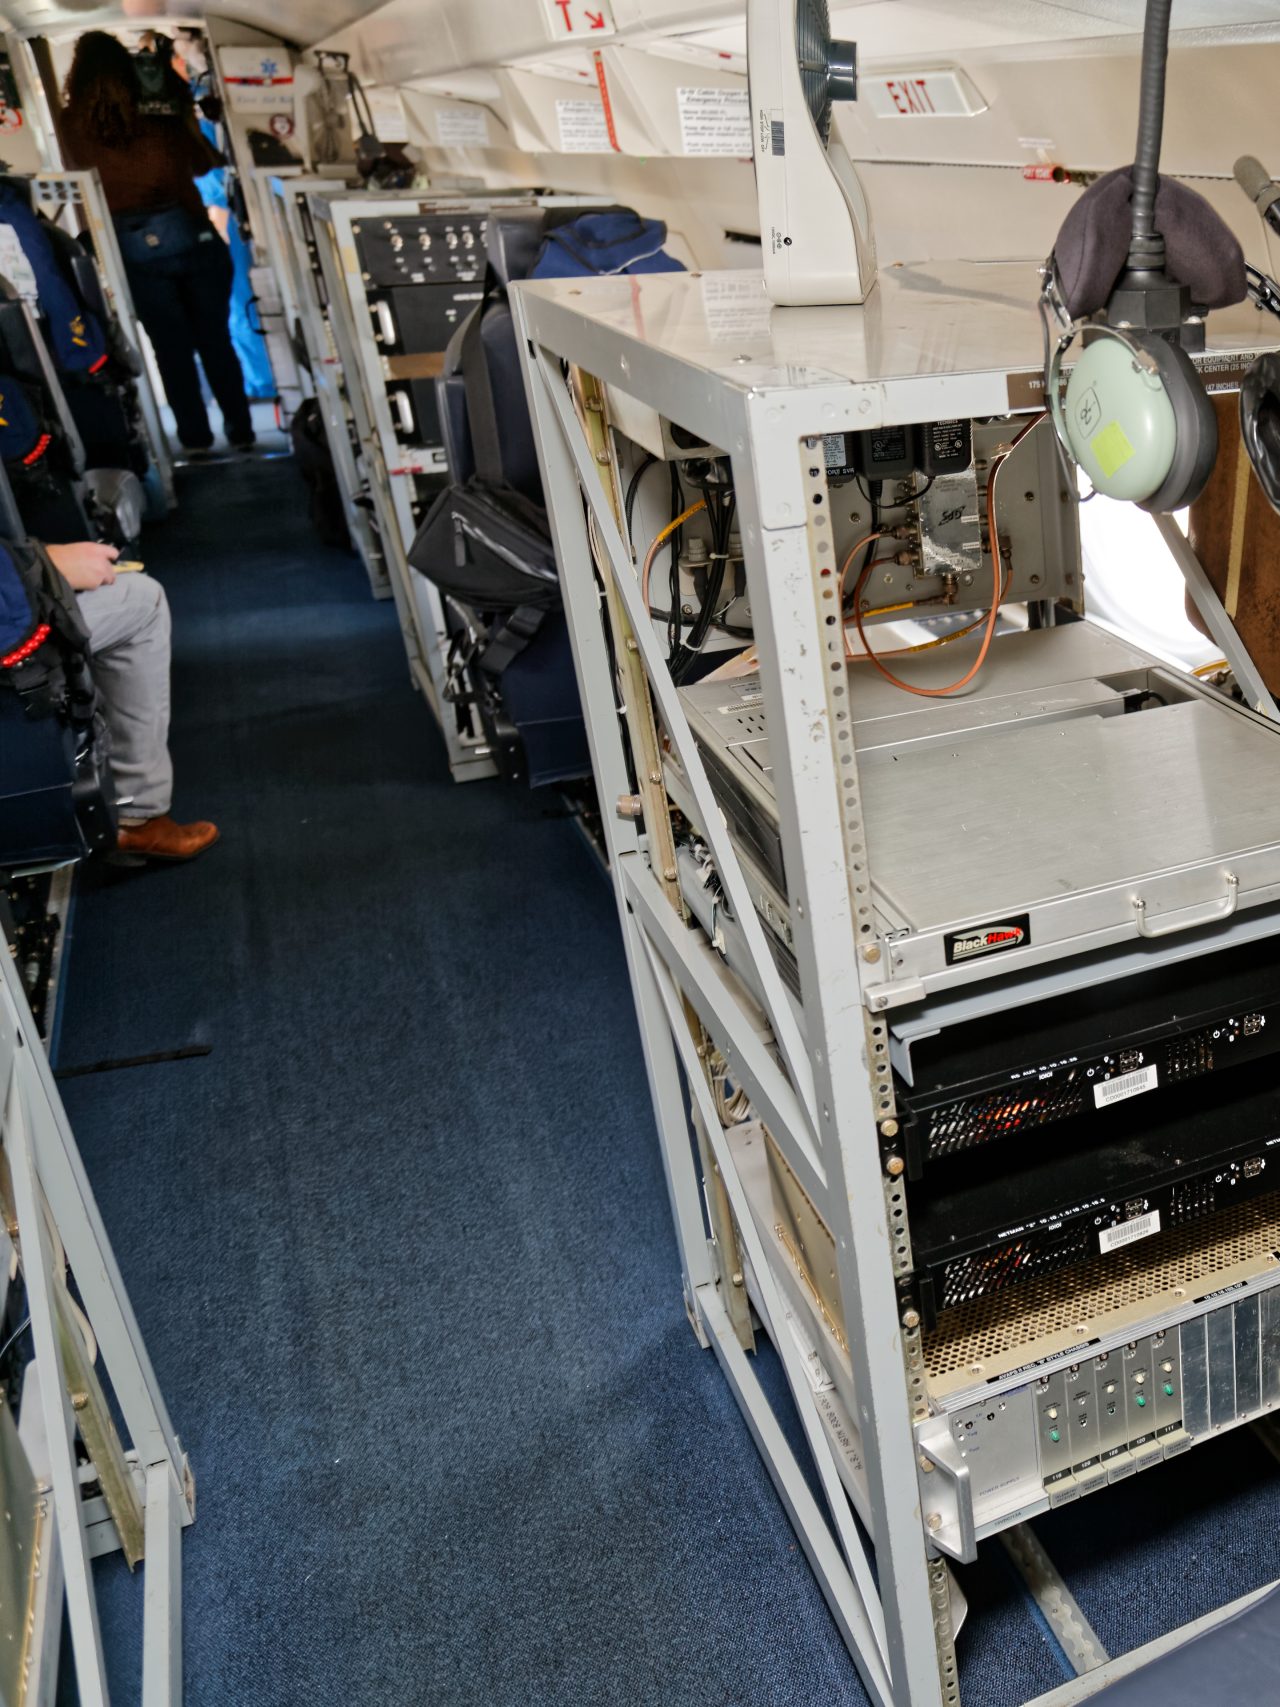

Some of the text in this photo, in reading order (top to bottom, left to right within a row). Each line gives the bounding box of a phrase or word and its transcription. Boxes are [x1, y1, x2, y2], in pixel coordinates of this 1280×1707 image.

[887, 80, 936, 114] EXIT
[1204, 354, 1238, 363] EQUIPMENT
[953, 927, 1022, 953] BlackHawk
[998, 1226, 1024, 1238] NETMAN
[997, 1368, 1018, 1380] AVAPS
[1045, 1351, 1064, 1361] STYLE
[1064, 1341, 1089, 1354] CHASSIS
[1165, 1425, 1174, 1433] 111
